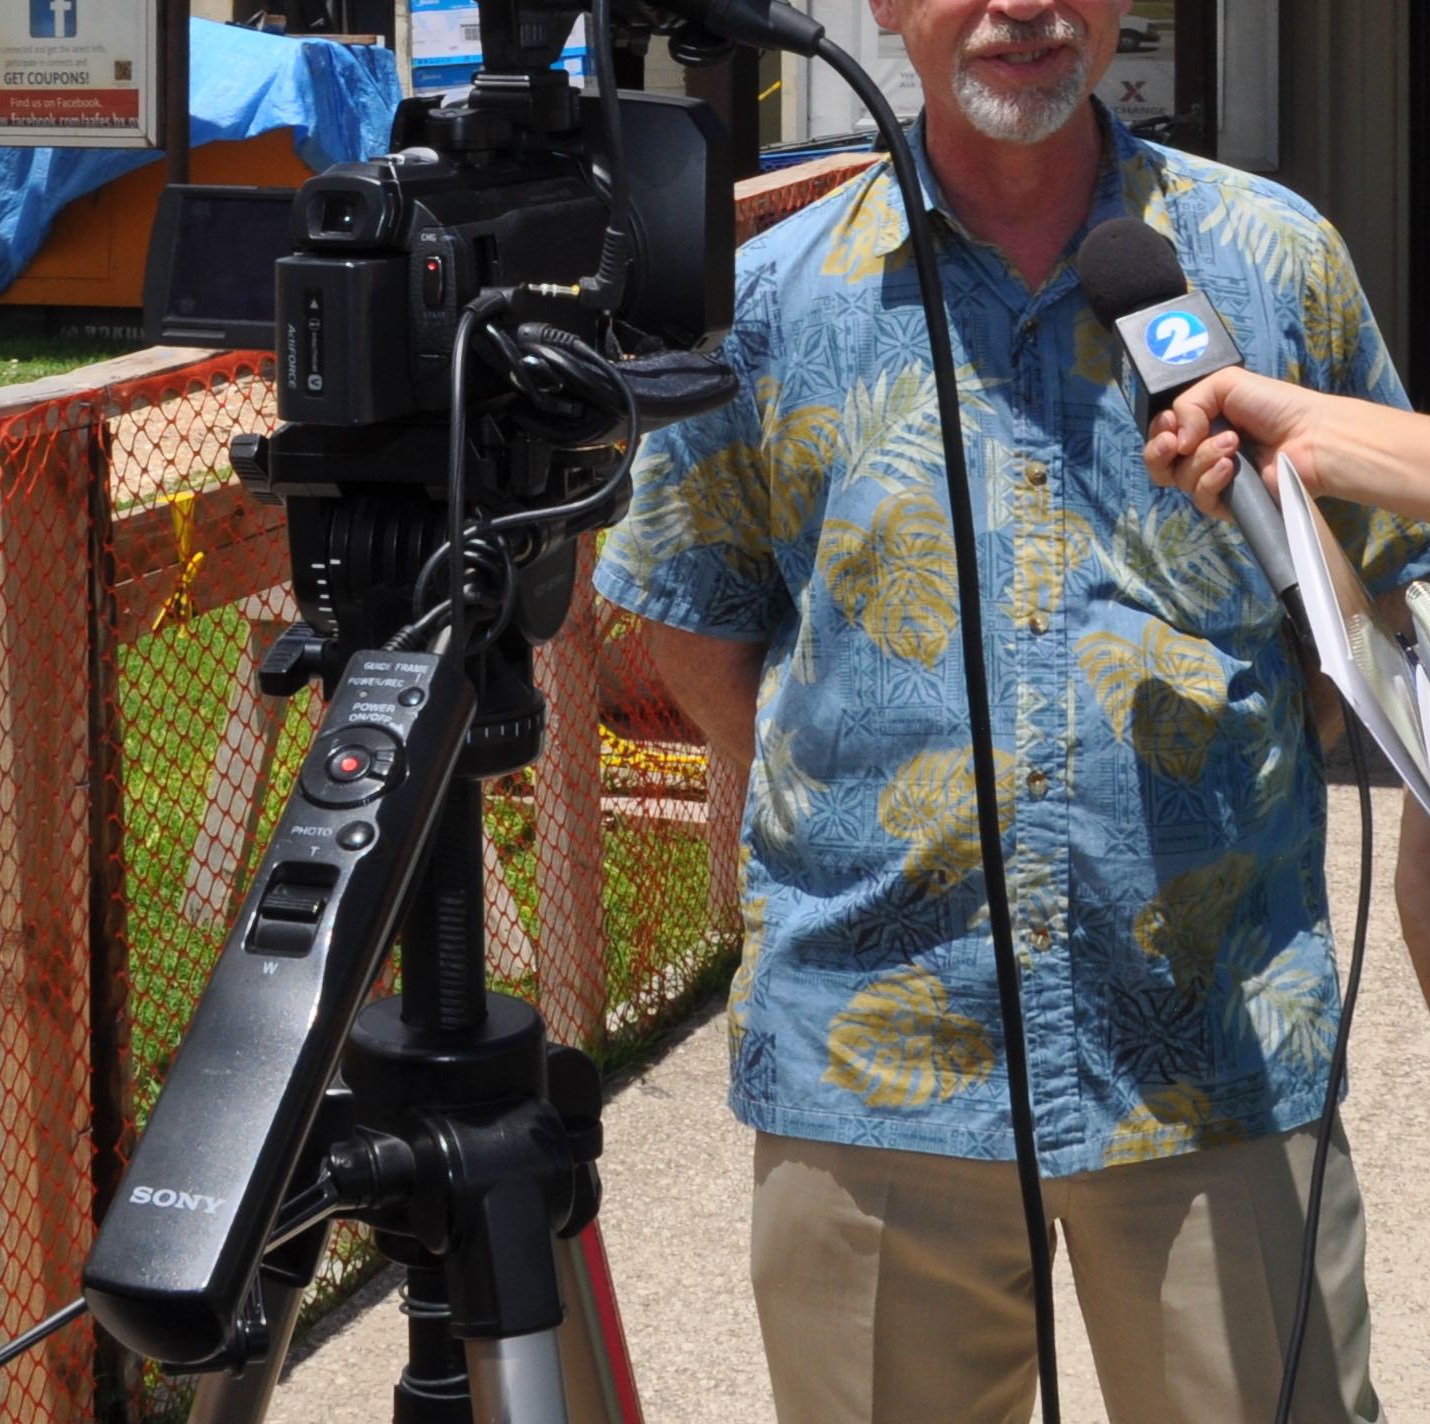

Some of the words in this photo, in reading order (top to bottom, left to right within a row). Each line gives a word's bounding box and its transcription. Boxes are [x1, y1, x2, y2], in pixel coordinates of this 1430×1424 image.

[3, 71, 25, 85] GET
[27, 71, 90, 85] COUPONS!
[10, 97, 30, 108] Find
[32, 99, 42, 108] us
[43, 99, 56, 108] on
[395, 662, 430, 674] FRAME
[352, 703, 396, 713] POWER
[348, 713, 393, 723] ON/OFF
[291, 826, 333, 836] PHOTO
[310, 846, 320, 857] T
[263, 961, 279, 975] W
[129, 1186, 227, 1215] SONY
